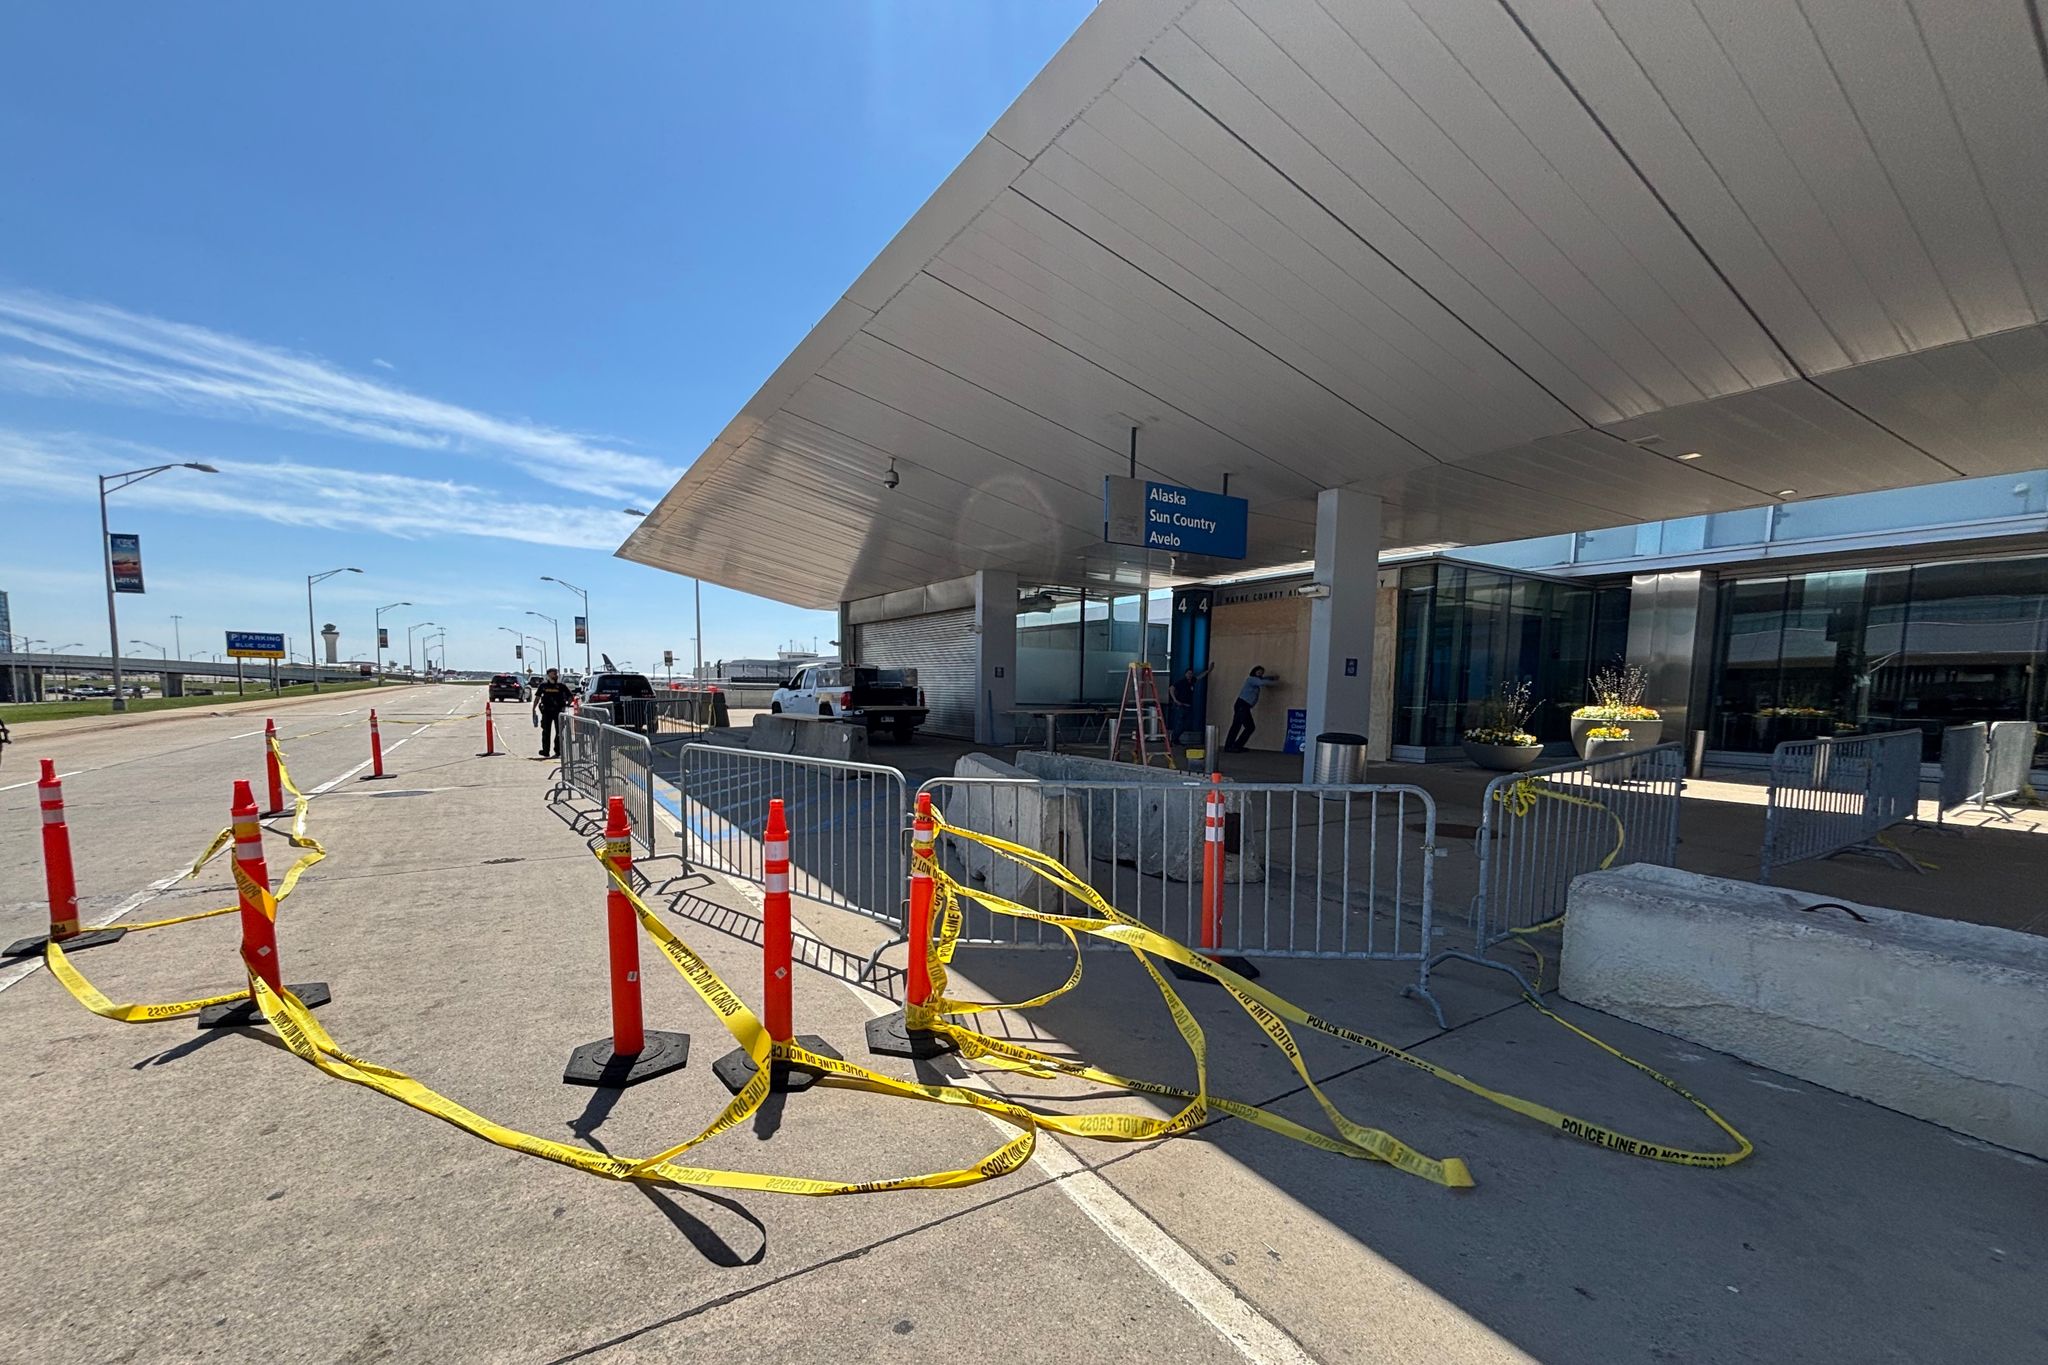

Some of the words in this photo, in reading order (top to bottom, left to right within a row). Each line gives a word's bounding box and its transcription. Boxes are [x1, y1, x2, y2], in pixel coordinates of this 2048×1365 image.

[1150, 488, 1186, 505] Alaska
[1150, 509, 1170, 523] Sun
[1173, 513, 1216, 533] Country
[1149, 531, 1180, 546] Avelo
[1253, 591, 1283, 600] COUNTY
[1178, 598, 1187, 612] 4
[1199, 598, 1208, 612] 4
[241, 634, 281, 642] PARKING
[916, 860, 931, 877] NOT
[944, 912, 960, 933] LINE
[664, 937, 693, 963] POLICE
[681, 957, 705, 976] LINE
[693, 970, 713, 985] DO
[700, 980, 724, 996] NOT
[712, 991, 742, 1016] CROSS
[1250, 1004, 1274, 1026] LINE
[1306, 1015, 1340, 1036] POLICE
[1341, 1030, 1364, 1045] LINE
[977, 1035, 1005, 1053] POLICE
[1005, 1046, 1024, 1058] LINE
[1268, 1021, 1298, 1058] POLICE
[784, 1046, 803, 1061] NOT
[805, 1052, 816, 1064] DO
[818, 1058, 839, 1070] LINE
[840, 1063, 870, 1080] POLICE
[746, 1078, 768, 1106] LINE
[736, 1100, 750, 1118] DO
[718, 1113, 736, 1131] NOT
[1562, 1118, 1606, 1144] POLICE
[1607, 1136, 1637, 1154] LINE
[1639, 1145, 1657, 1158] DO
[980, 1152, 1010, 1178] CROSS
